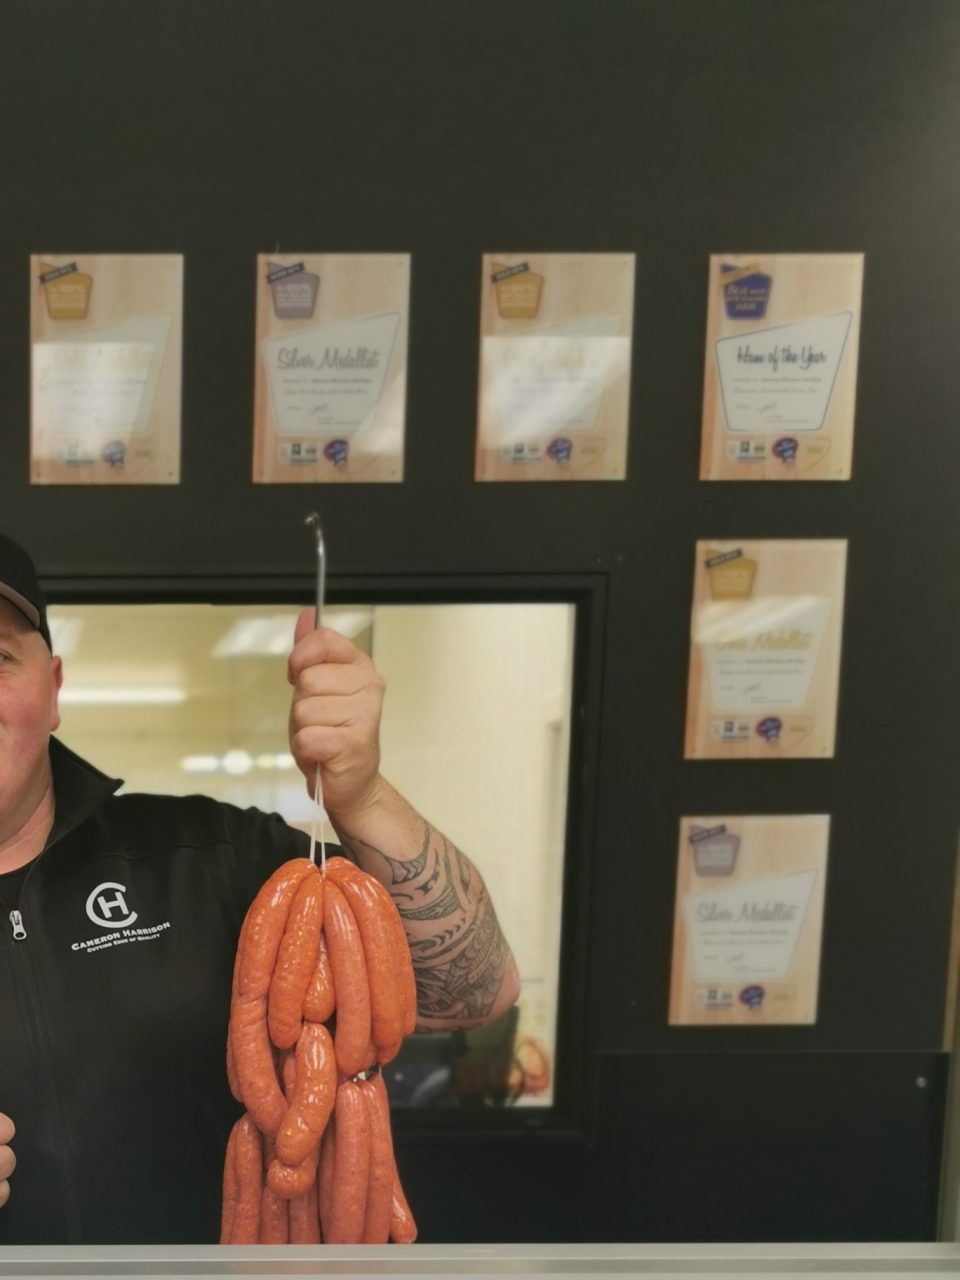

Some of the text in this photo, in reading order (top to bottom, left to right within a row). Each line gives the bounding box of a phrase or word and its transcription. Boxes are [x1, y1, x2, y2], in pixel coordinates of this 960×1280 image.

[277, 347, 314, 370] Silver
[767, 345, 779, 372] of
[781, 344, 798, 363] the
[799, 345, 827, 370] Year
